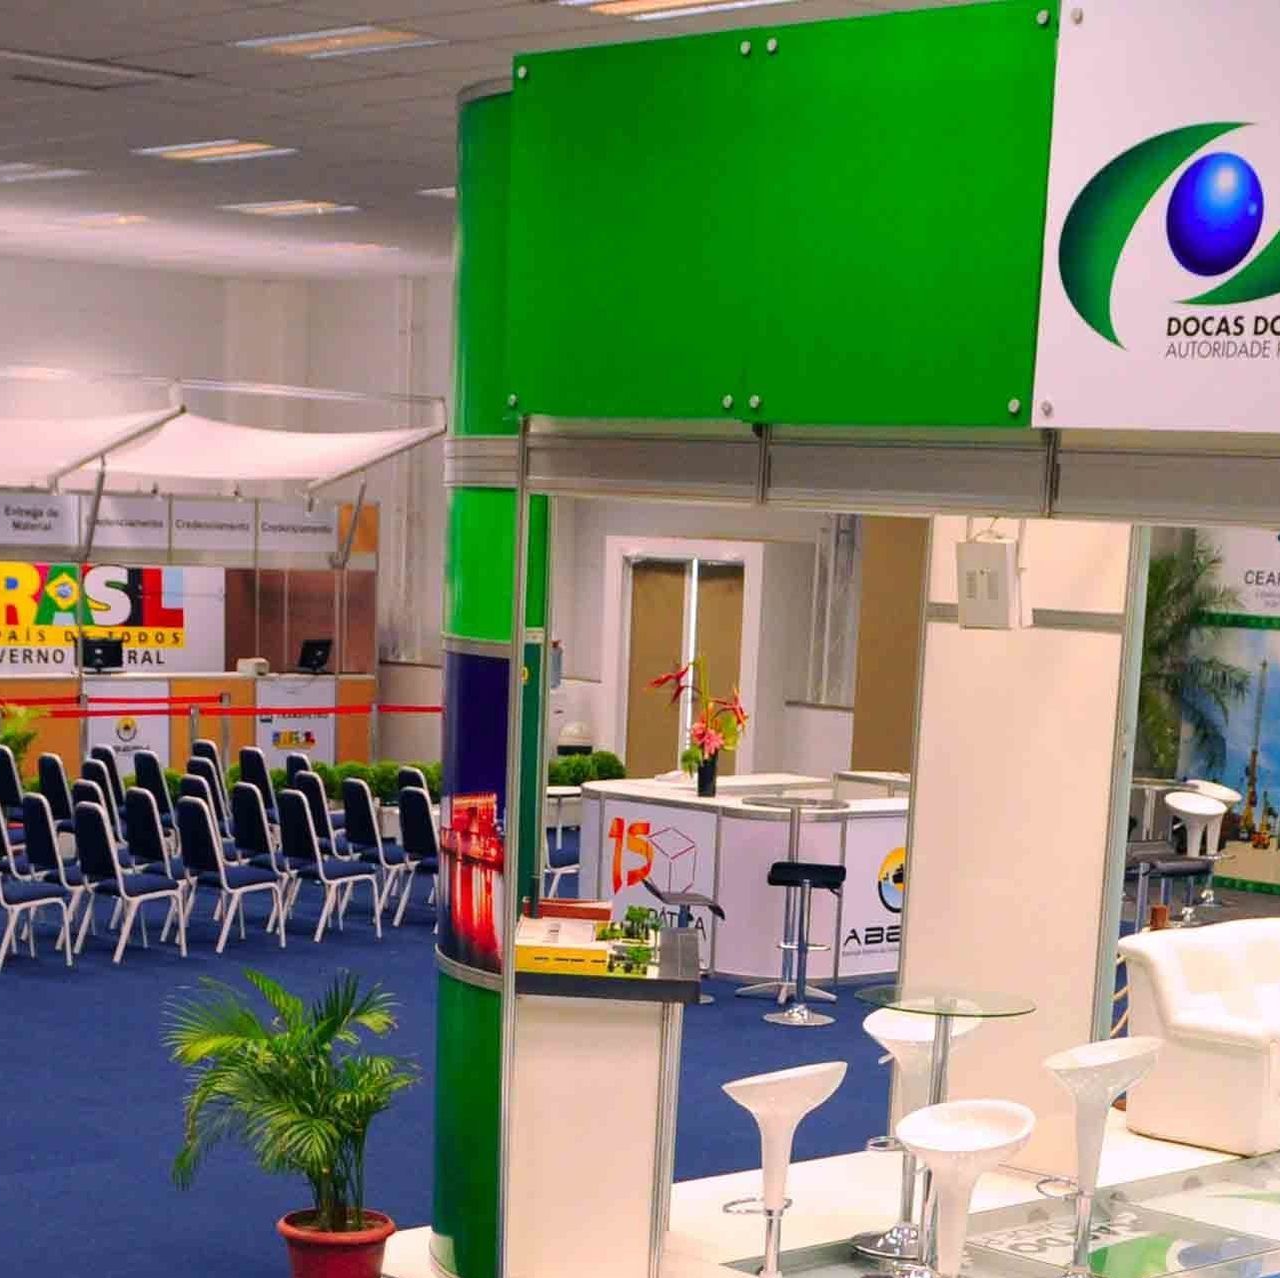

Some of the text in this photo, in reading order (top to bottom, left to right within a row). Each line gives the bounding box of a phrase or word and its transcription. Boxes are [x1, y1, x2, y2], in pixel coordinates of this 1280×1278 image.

[1166, 316, 1245, 337] DOCAS
[1165, 340, 1271, 359] AUTORIDADE
[608, 816, 655, 896] 15
[843, 924, 901, 947] ABE
